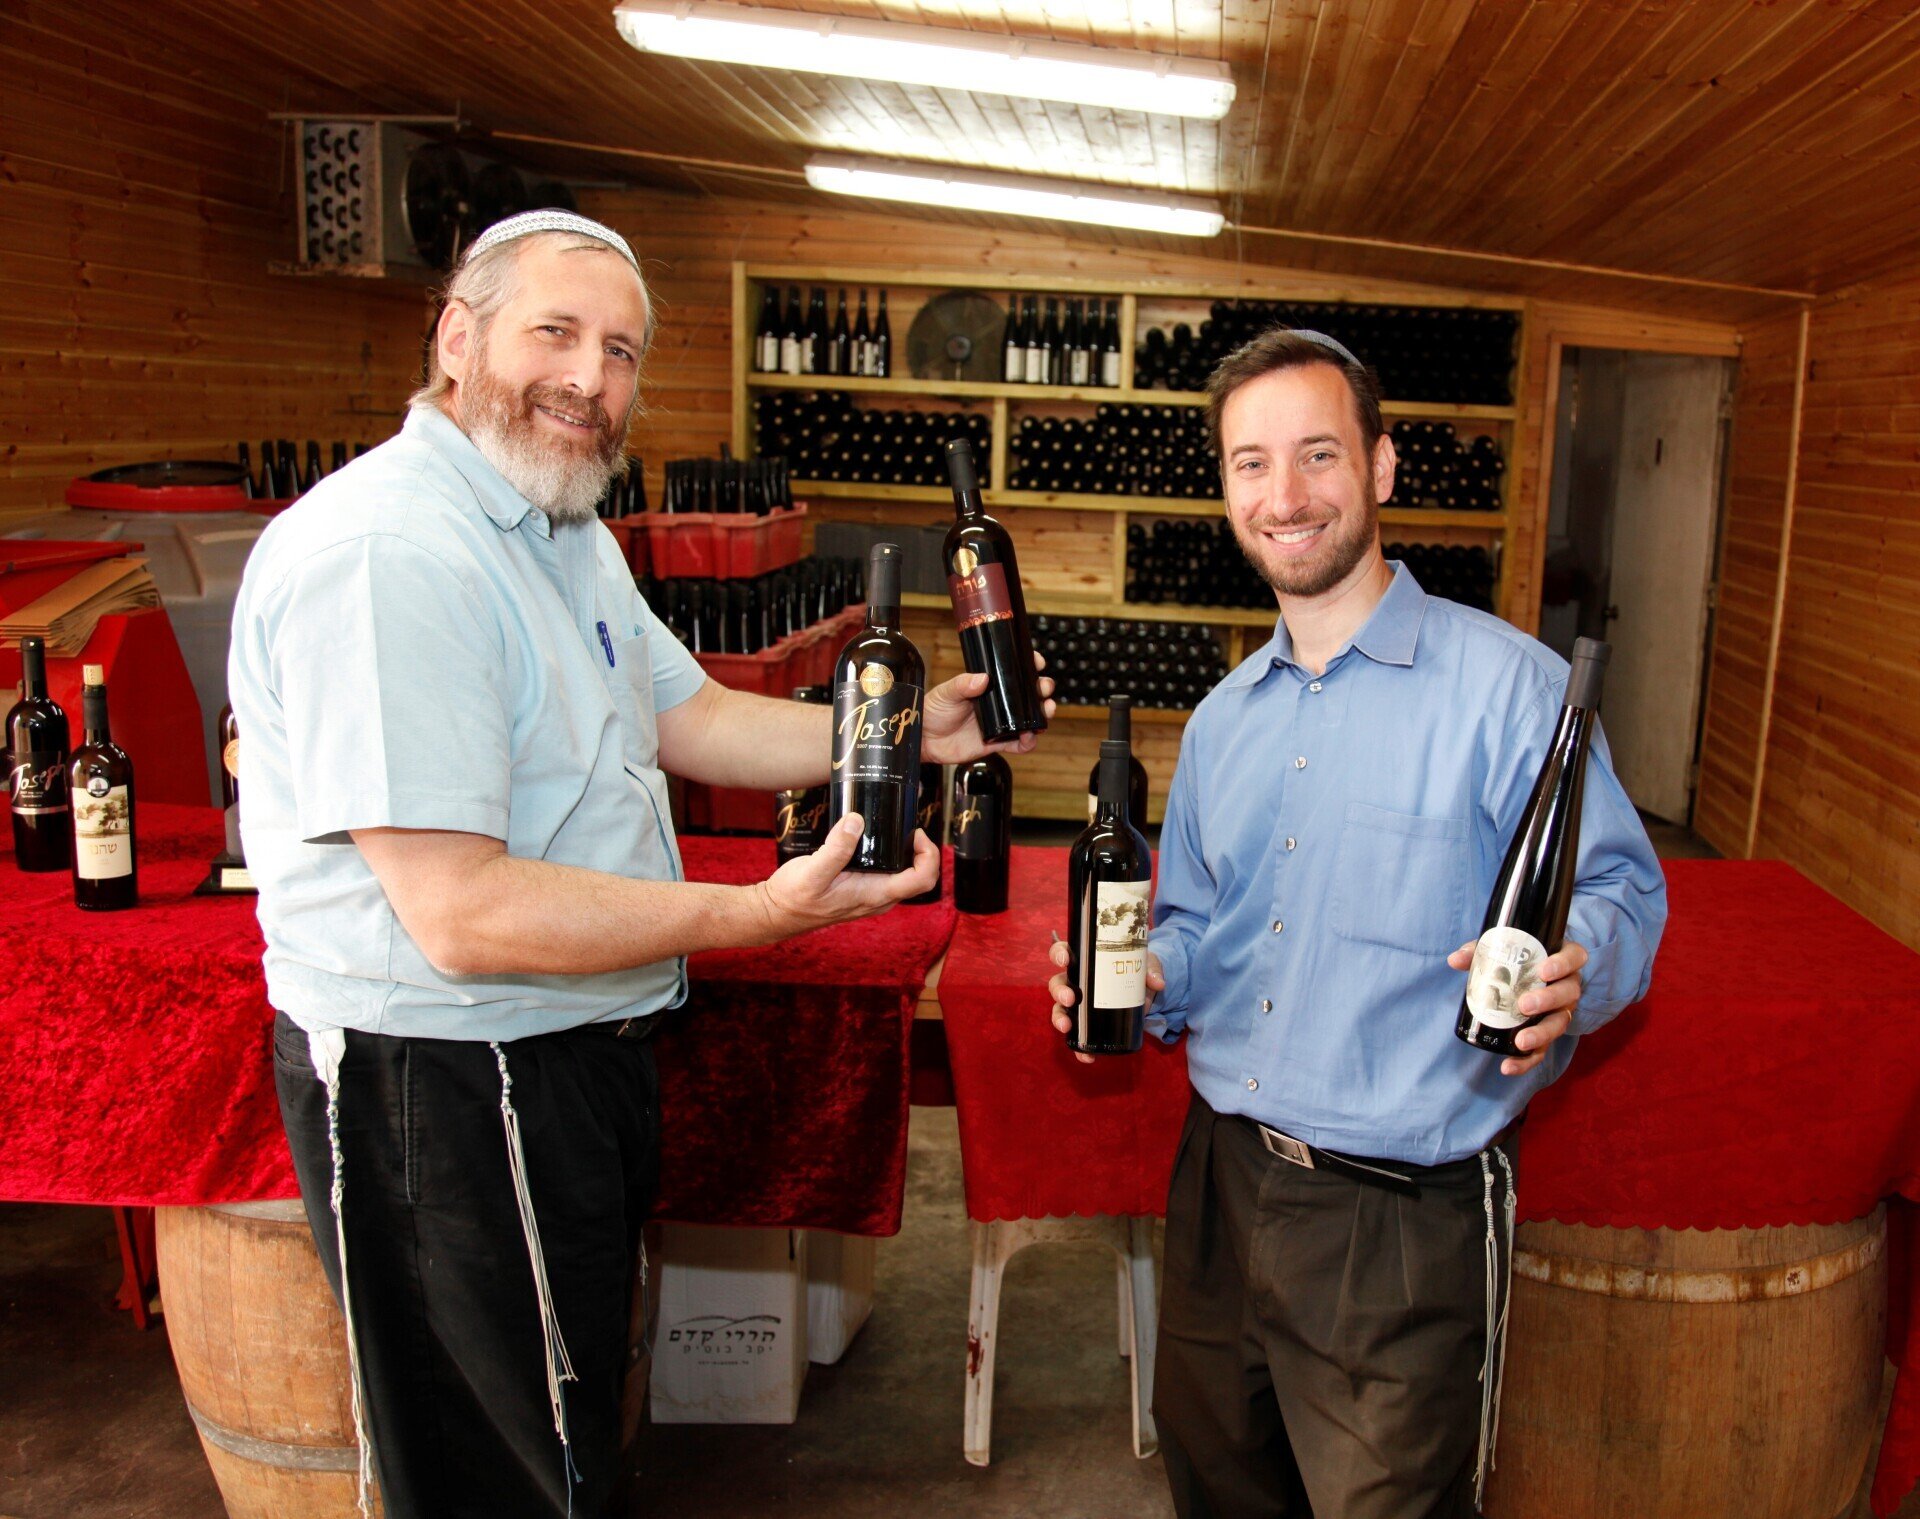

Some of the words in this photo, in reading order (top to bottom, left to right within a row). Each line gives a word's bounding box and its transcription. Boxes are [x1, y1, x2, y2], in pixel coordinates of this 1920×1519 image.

[956, 574, 987, 596] פורה
[832, 687, 921, 770] Joseph
[9, 750, 67, 803] Joseph
[1113, 958, 1143, 975] שהם
[669, 1329, 715, 1346] קדם
[725, 1329, 776, 1343] הררי
[683, 1344, 732, 1354] בוטיק
[745, 1345, 773, 1355] יקב
